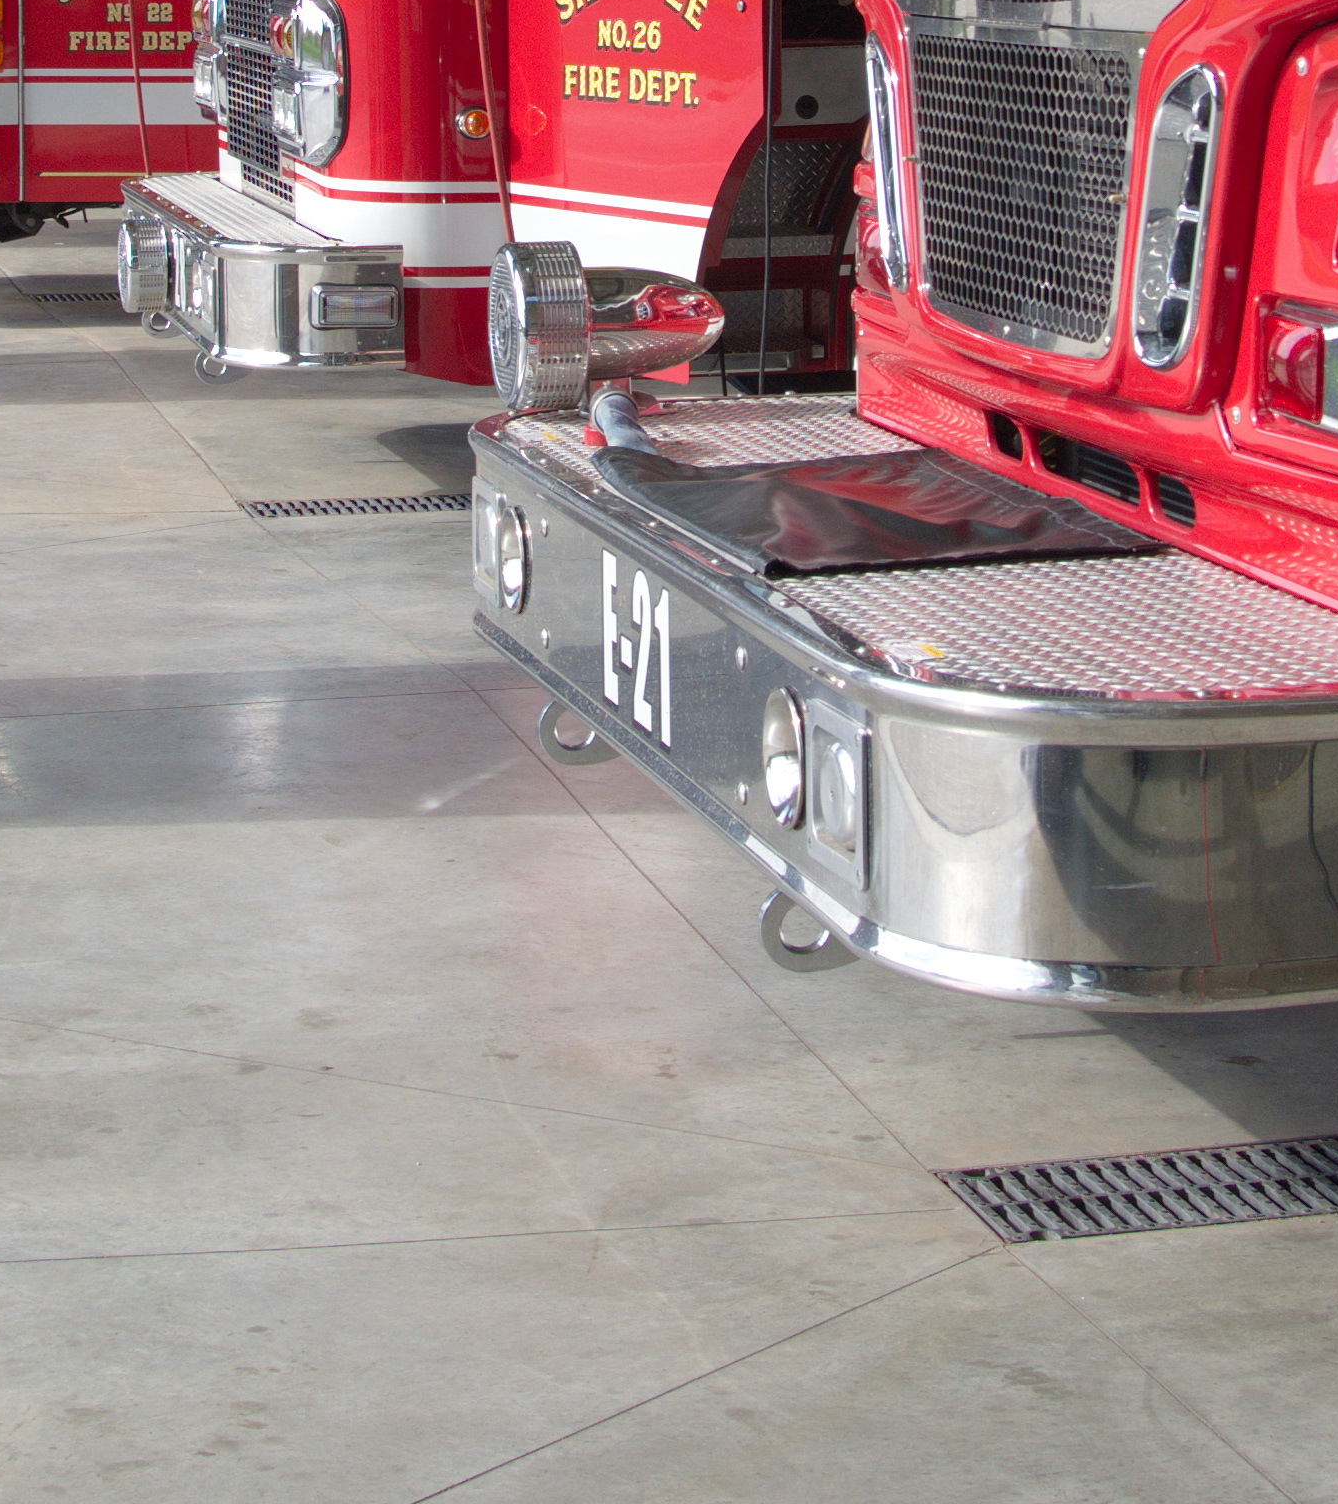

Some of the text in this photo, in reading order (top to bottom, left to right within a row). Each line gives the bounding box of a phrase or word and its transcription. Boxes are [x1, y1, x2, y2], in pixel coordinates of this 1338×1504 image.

[147, 2, 174, 24] 22
[68, 31, 131, 53] FIRE
[596, 19, 662, 54] NO.26
[563, 64, 701, 109] FIRE DEPT.
[601, 547, 671, 750] E-21
